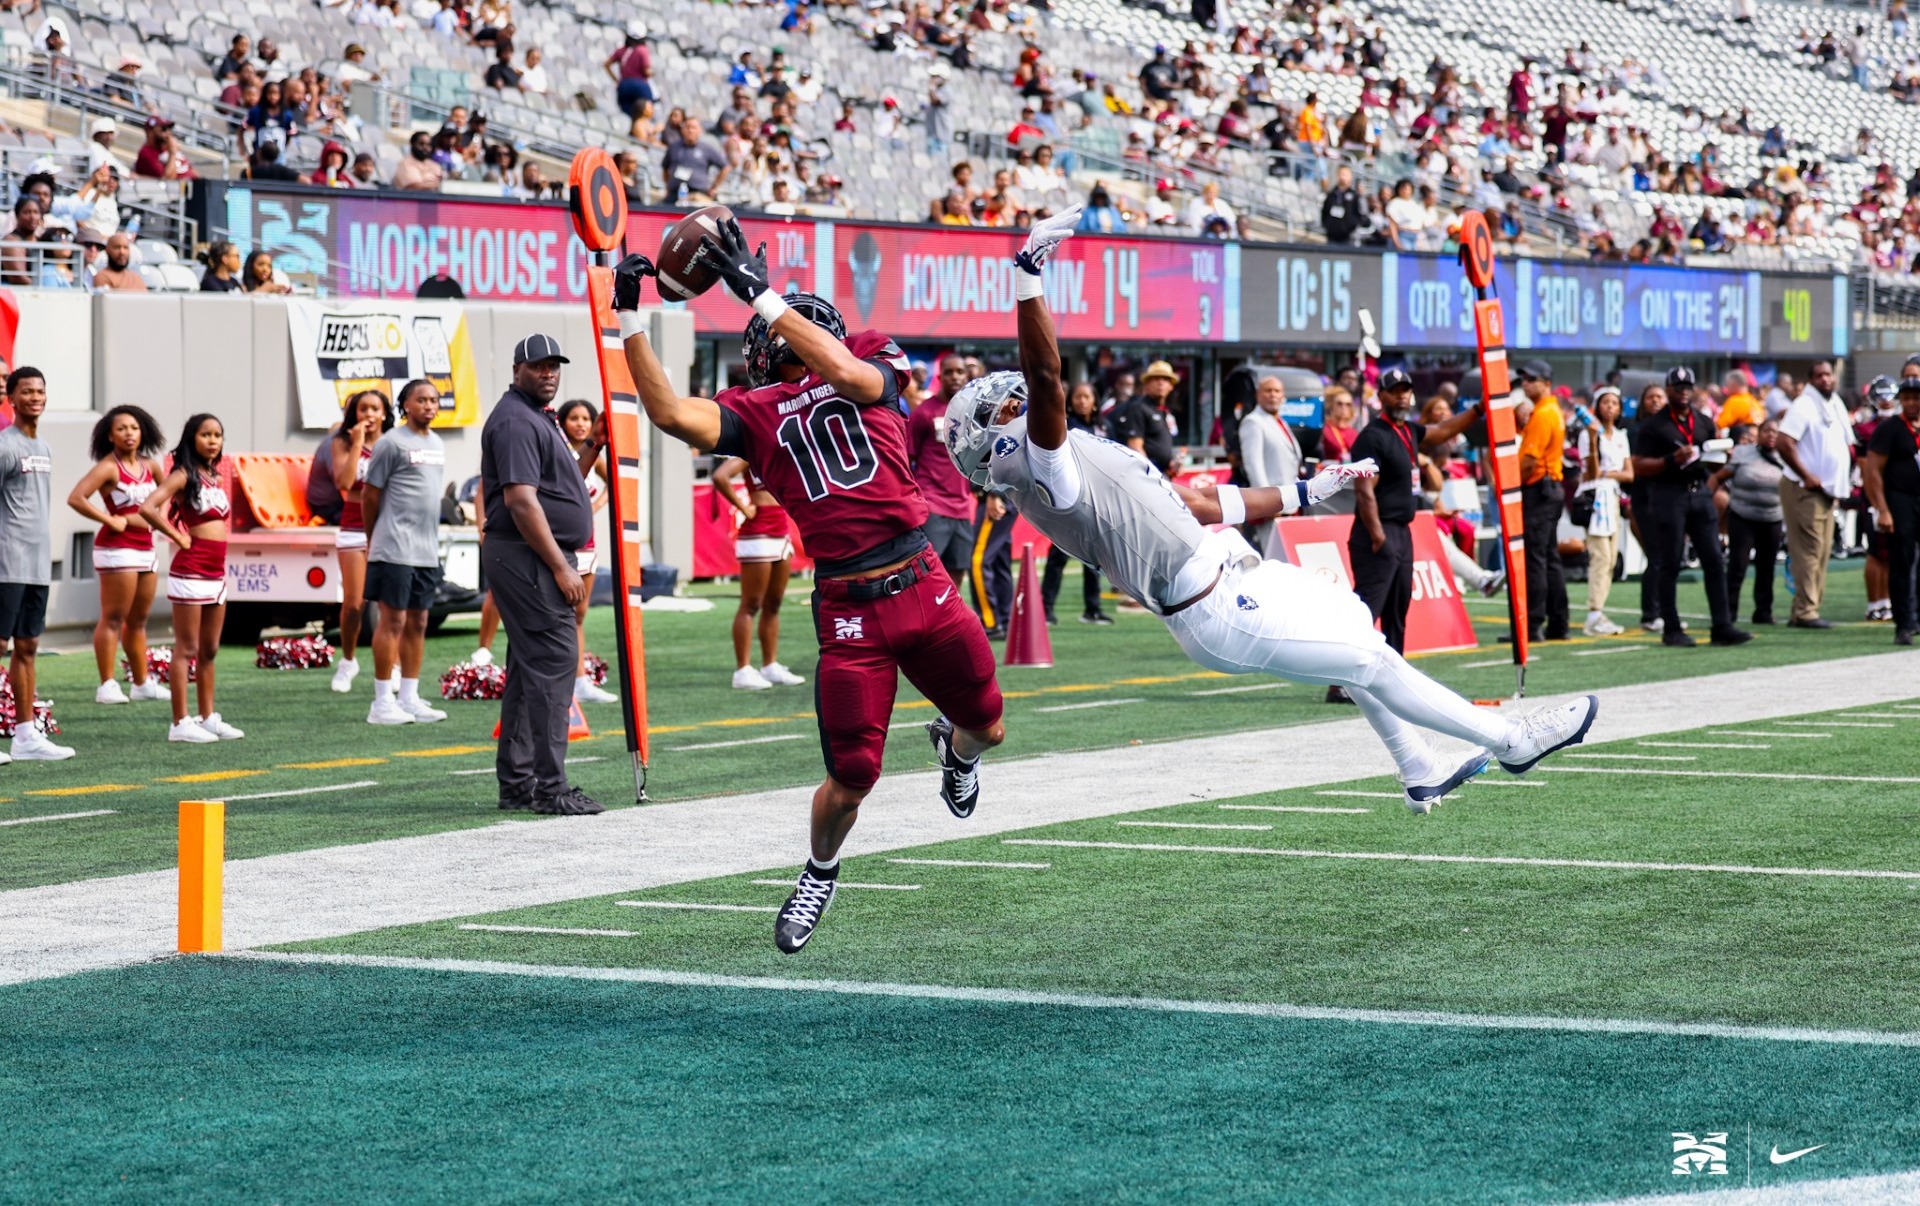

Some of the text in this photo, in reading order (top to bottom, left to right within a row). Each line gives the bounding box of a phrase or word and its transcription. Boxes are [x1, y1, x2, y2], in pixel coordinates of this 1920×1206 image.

[350, 222, 558, 296] MOREHOUSE
[775, 230, 809, 268] TOL
[1190, 249, 1220, 284] TOL
[902, 253, 1089, 315] HOWARD NIV.
[1103, 246, 1140, 330] 14
[1277, 257, 1352, 332] 10:15
[1408, 280, 1452, 331] QTR
[1459, 275, 1474, 333] 3
[1537, 275, 1579, 335] 3RD
[1582, 287, 1598, 325] &
[1602, 278, 1624, 336] 18
[1640, 289, 1671, 330] ON
[1673, 290, 1713, 331] THE
[1718, 284, 1744, 340] 24
[1198, 294, 1212, 337] 3
[1782, 288, 1811, 343] 40
[777, 383, 838, 416] MAROON TIGER
[776, 397, 879, 502] 10
[228, 563, 279, 578] NJSEA
[237, 578, 270, 592] EMS
